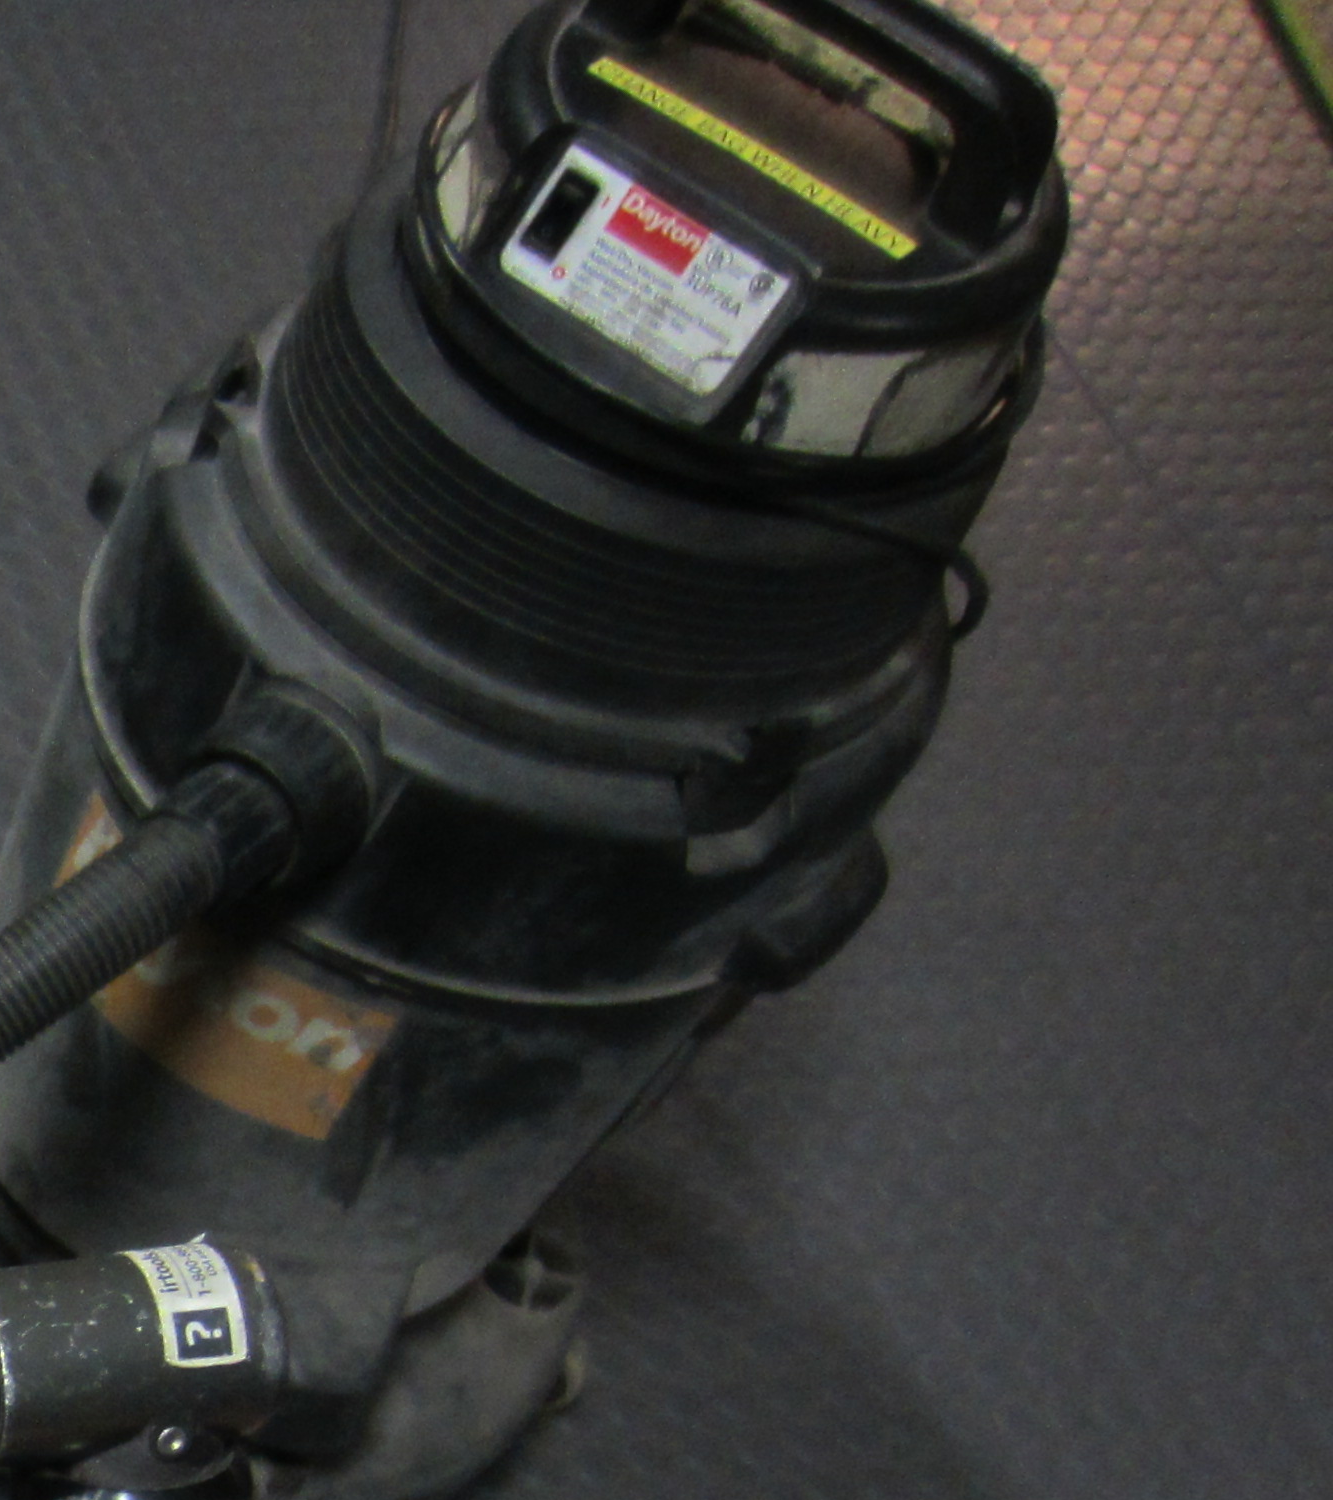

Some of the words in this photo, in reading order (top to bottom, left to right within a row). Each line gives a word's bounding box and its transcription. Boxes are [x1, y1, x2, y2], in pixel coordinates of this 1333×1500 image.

[595, 64, 686, 117] CHANGE
[696, 119, 746, 153] BAG
[752, 149, 817, 199] WHEN
[830, 195, 903, 250] HEAVY
[620, 191, 703, 253] Dayton
